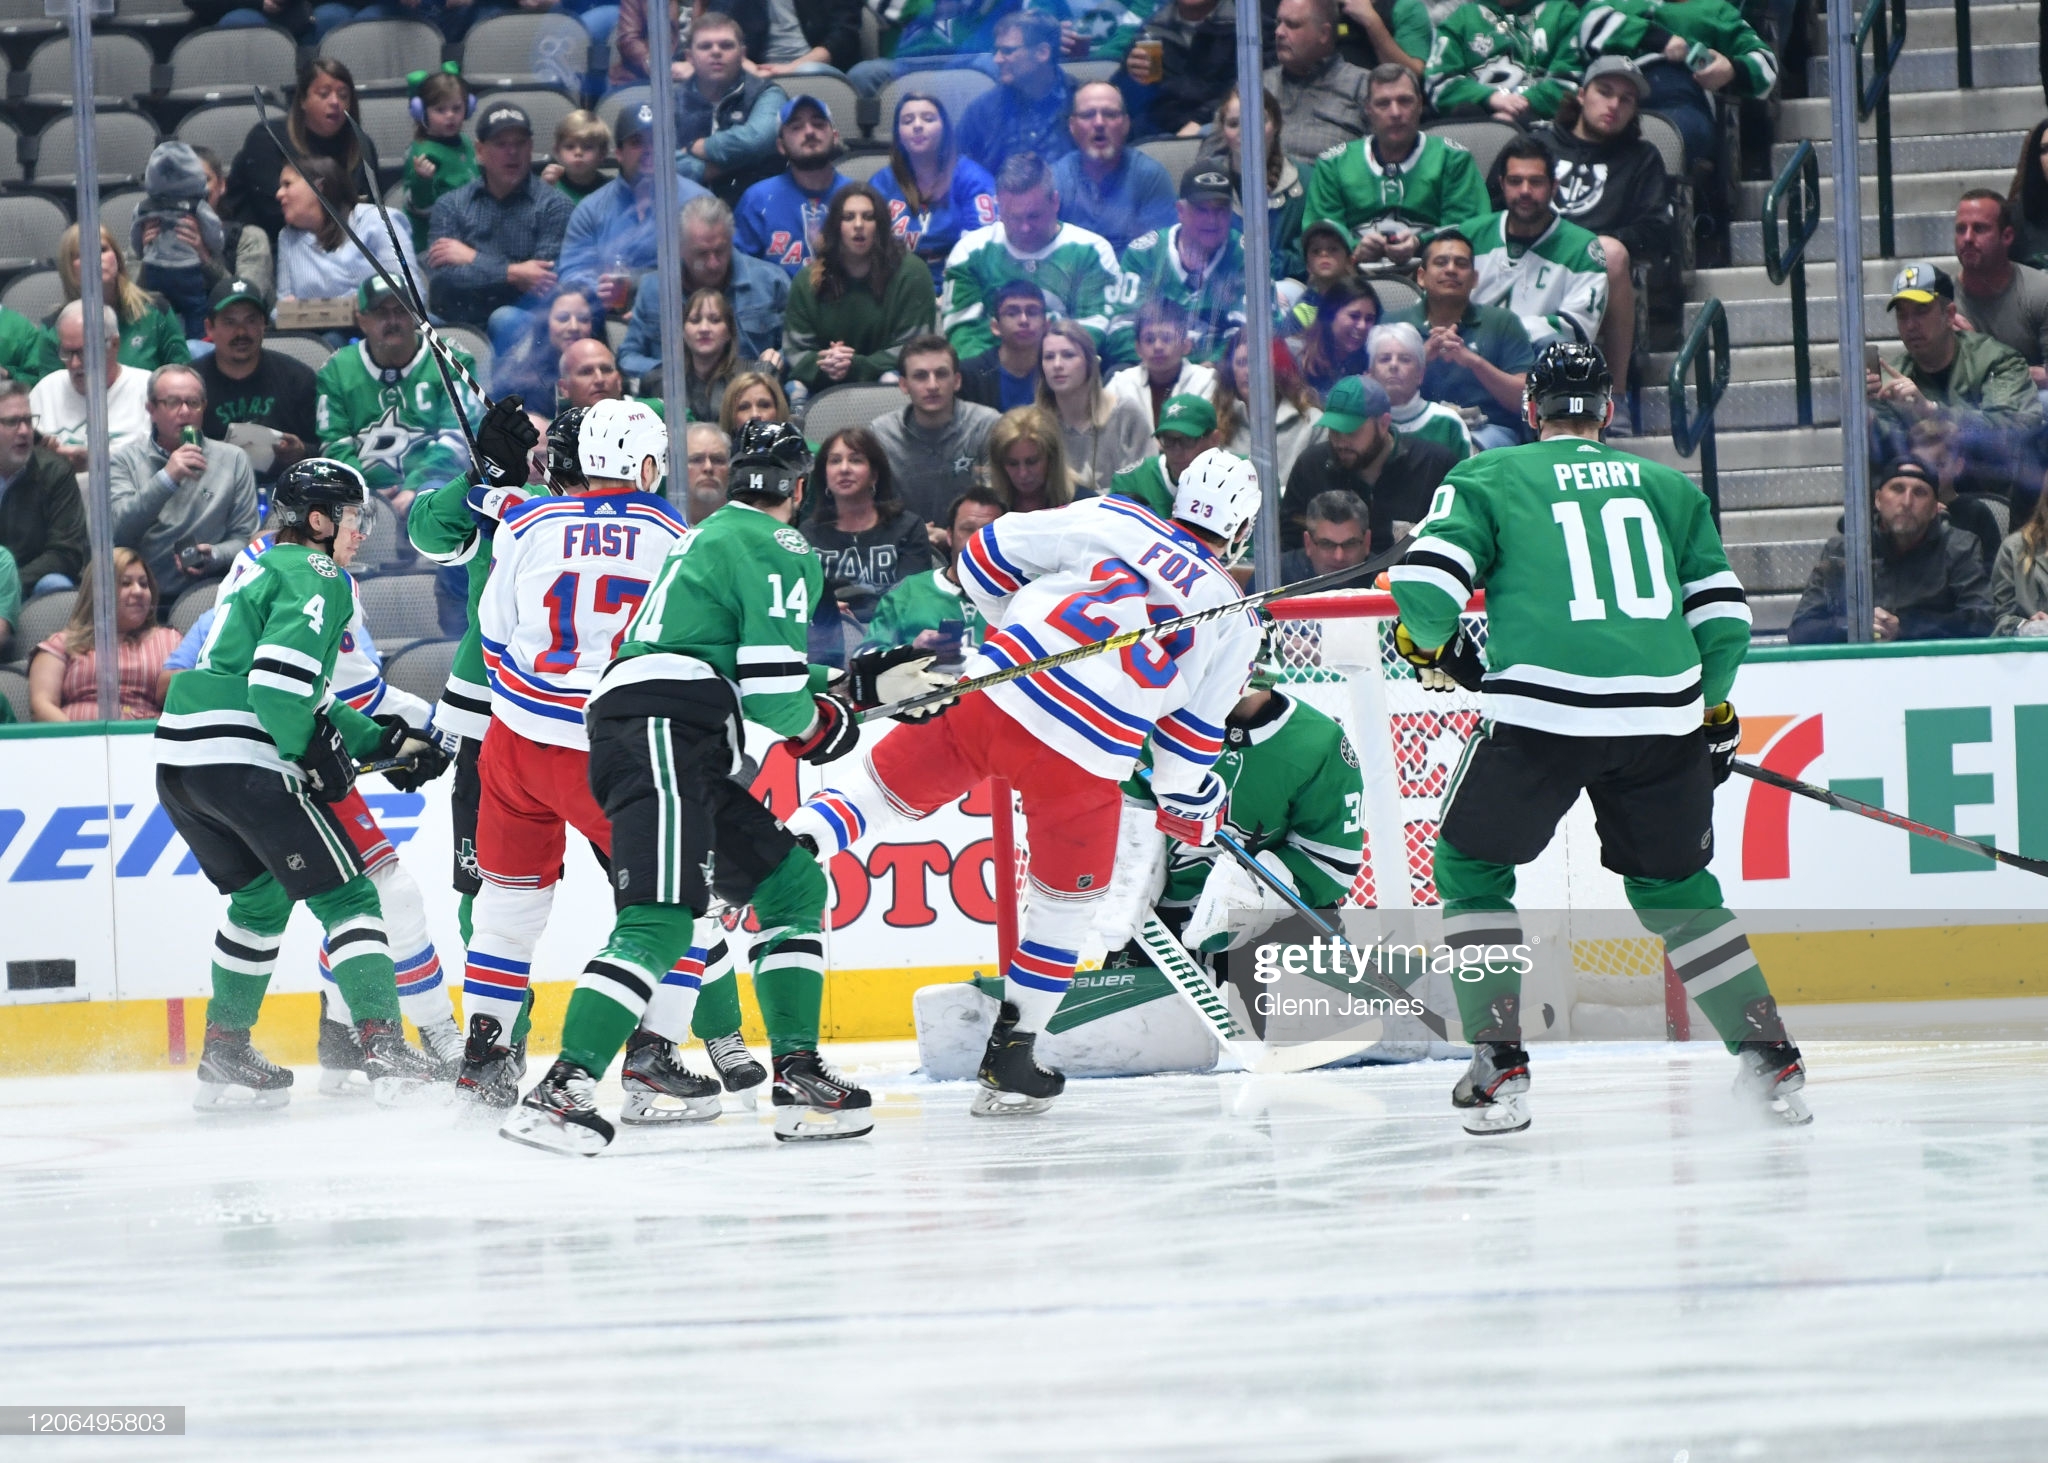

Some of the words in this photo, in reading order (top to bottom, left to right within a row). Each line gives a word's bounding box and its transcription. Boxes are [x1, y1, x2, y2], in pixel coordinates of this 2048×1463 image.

[1569, 397, 1584, 414] 10
[589, 454, 606, 469] 17
[749, 472, 763, 489] 14
[1553, 461, 1641, 491] PERRY
[1189, 500, 1214, 518] 23
[563, 523, 641, 561] FAST
[1551, 497, 1673, 621] 10
[813, 543, 899, 586] TAR
[1138, 541, 1208, 598] FOX
[302, 593, 326, 635] 4
[768, 573, 808, 624] 14
[1044, 557, 1196, 689] 23
[1343, 792, 1366, 834] 3
[815, 1081, 842, 1098] CCM
